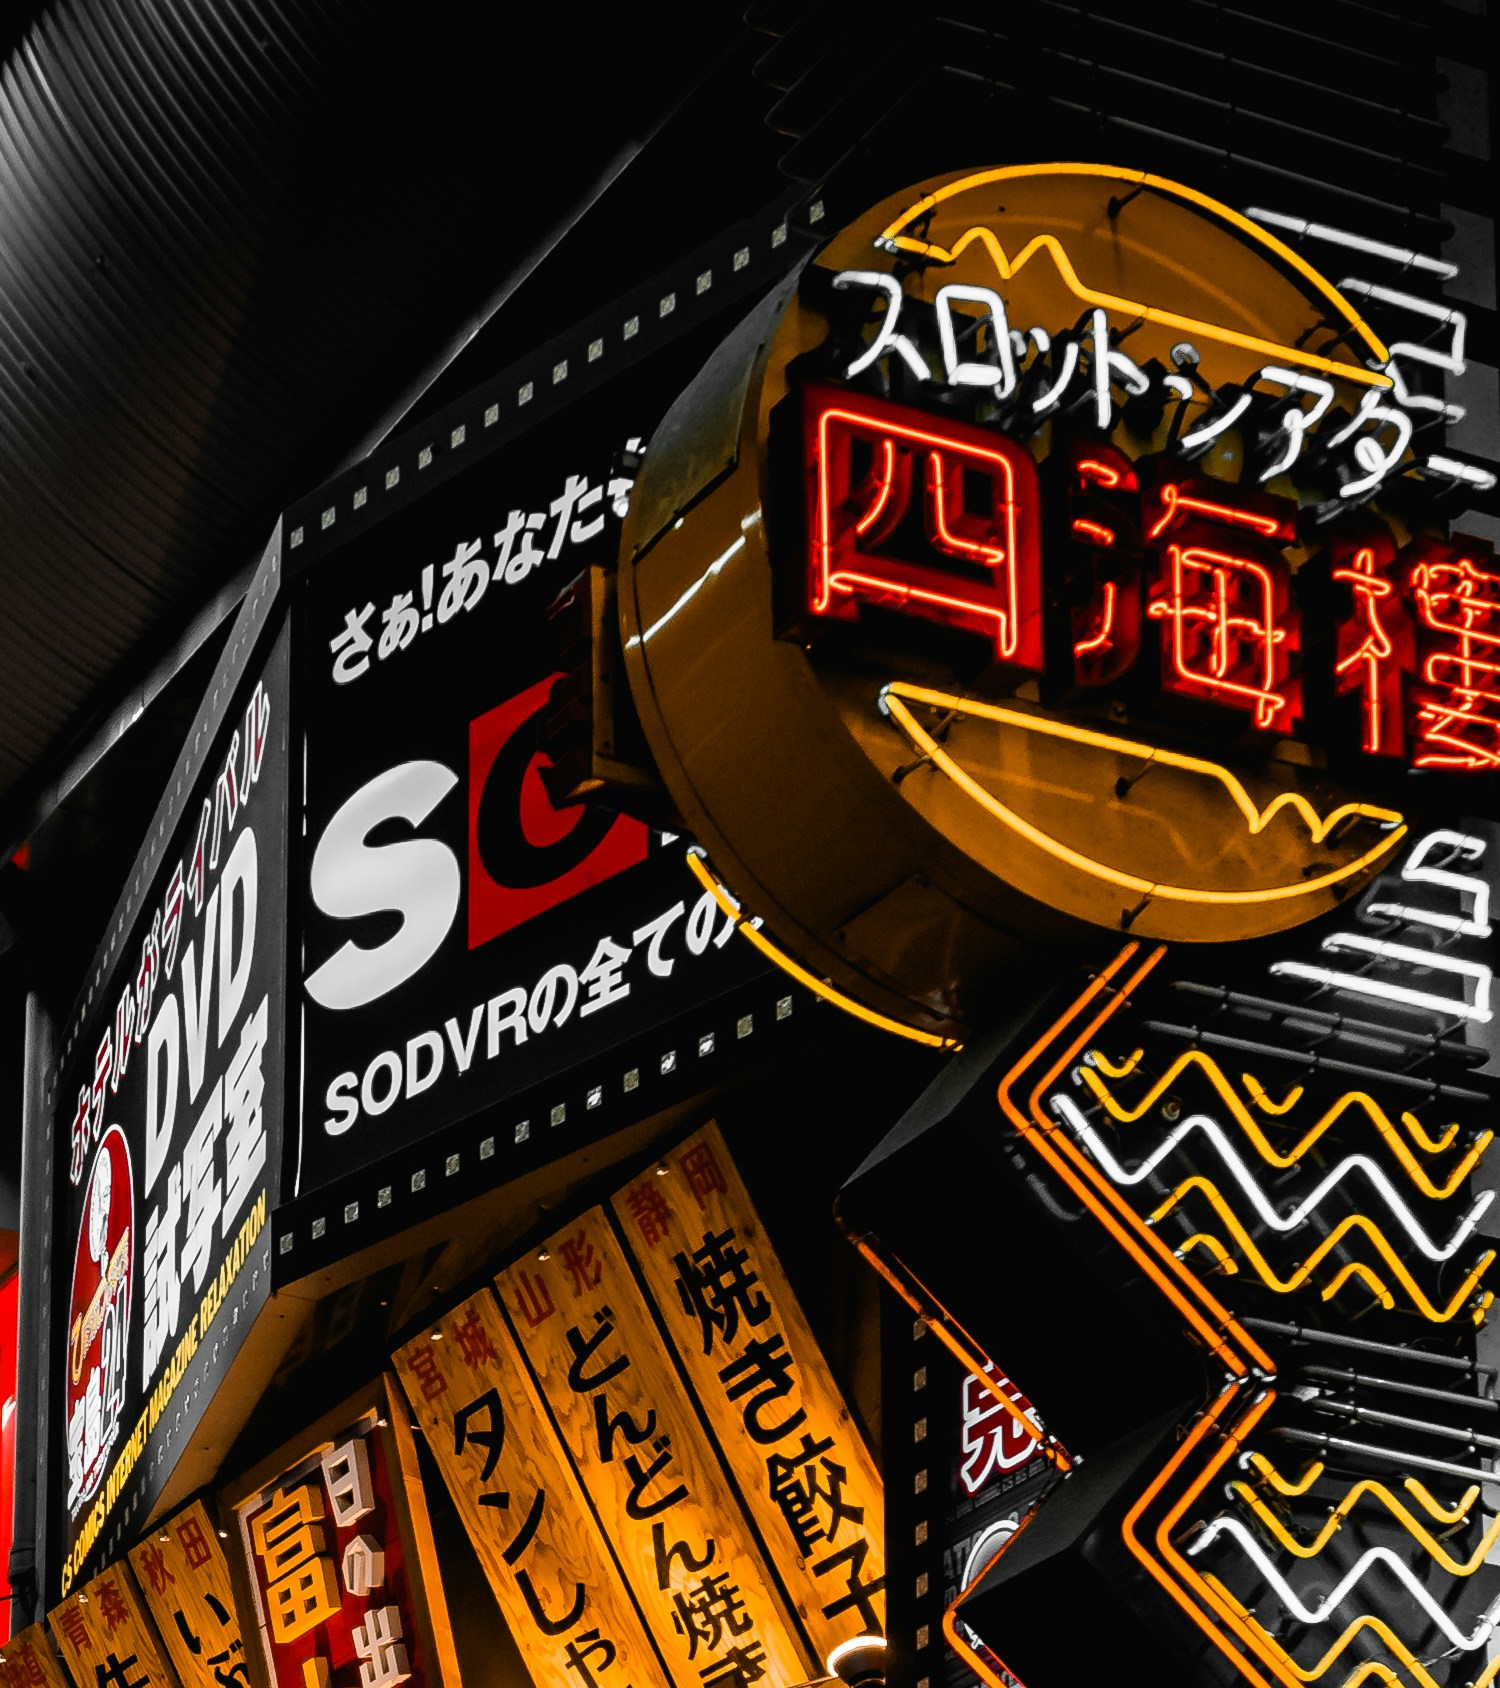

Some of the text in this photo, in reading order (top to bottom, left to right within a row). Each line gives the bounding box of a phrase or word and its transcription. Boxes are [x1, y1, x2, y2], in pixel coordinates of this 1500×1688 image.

[145, 826, 259, 1198] DVD
[143, 990, 269, 1393] 試写室
[627, 1140, 729, 1247] 静岡
[514, 1228, 603, 1329] 山形
[73, 1496, 107, 1570] COMICS
[106, 1407, 149, 1517] INTERNET
[149, 1314, 198, 1433] MAGAZINE
[199, 1187, 267, 1330] RELAXATION
[406, 1307, 501, 1399] 宮城
[673, 1225, 886, 1637] 焼き餃子
[141, 1517, 213, 1597] 秋田
[58, 1580, 131, 1657] 青森
